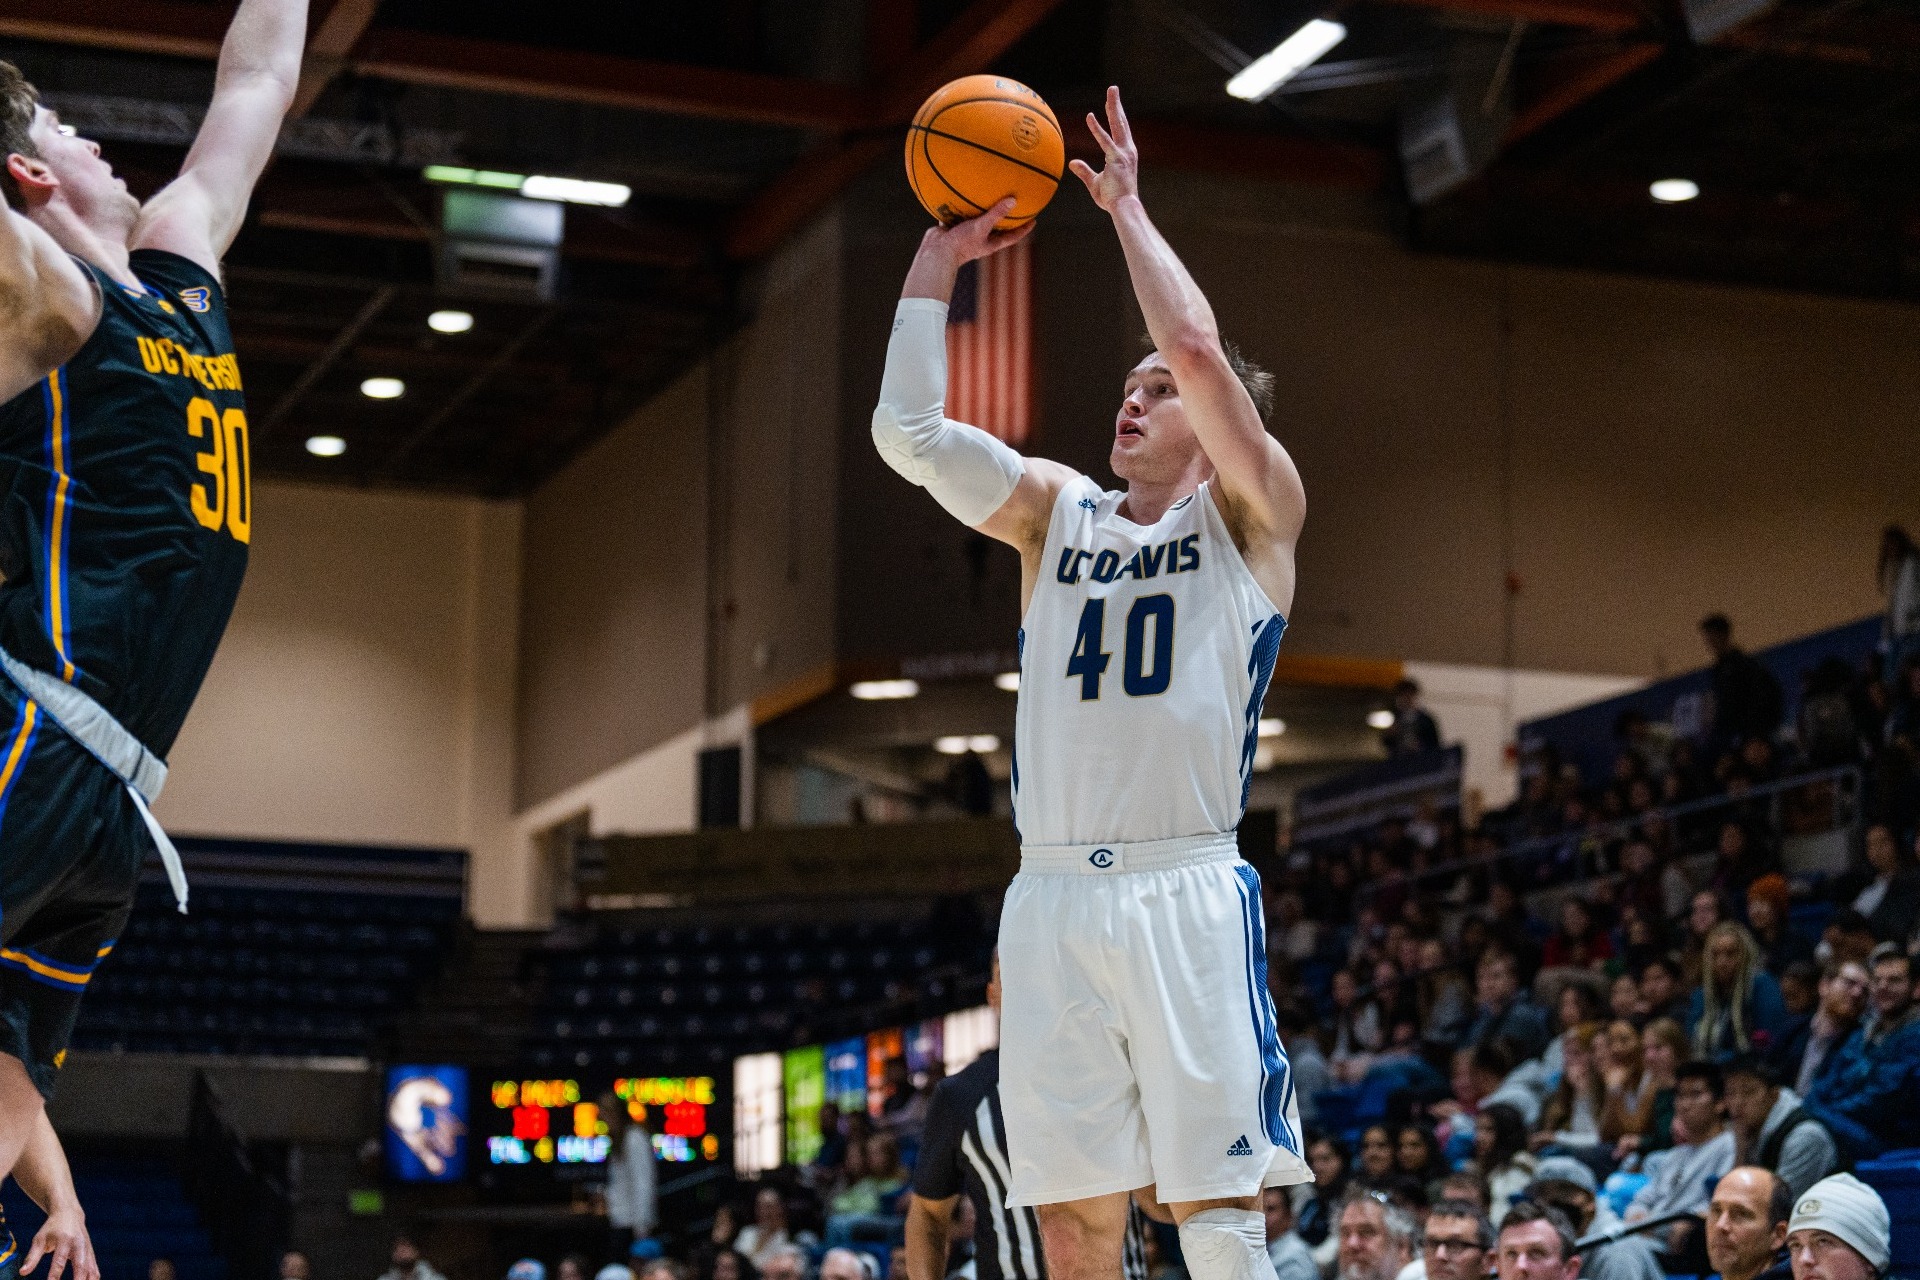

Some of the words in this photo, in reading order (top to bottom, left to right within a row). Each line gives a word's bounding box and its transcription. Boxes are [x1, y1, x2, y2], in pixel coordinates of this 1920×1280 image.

[136, 336, 180, 375] UC
[186, 396, 250, 545] 30
[1089, 533, 1200, 584] DAVIS
[1065, 592, 1176, 702] 40
[1226, 1147, 1253, 1156] adidas
